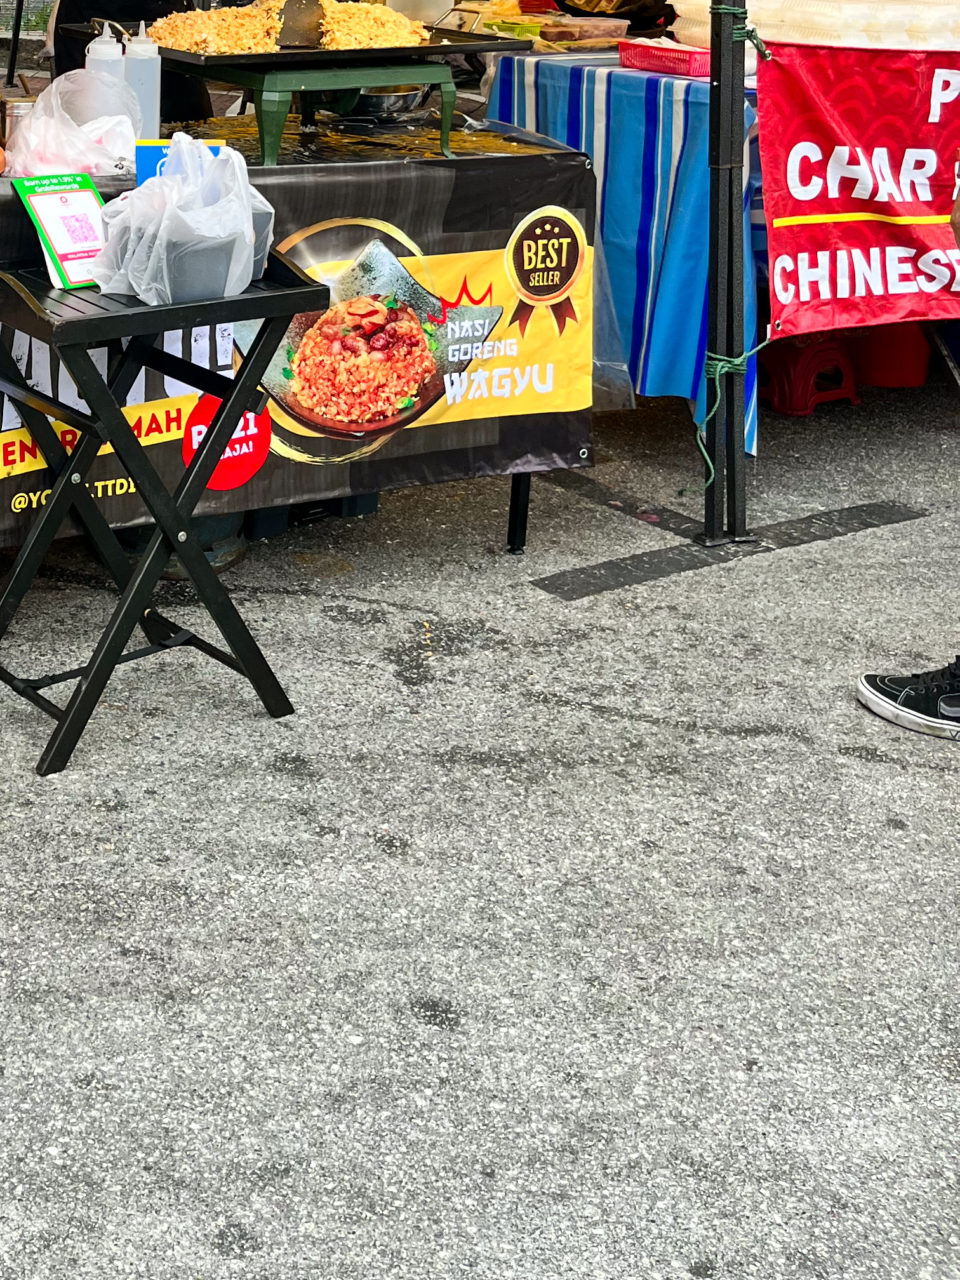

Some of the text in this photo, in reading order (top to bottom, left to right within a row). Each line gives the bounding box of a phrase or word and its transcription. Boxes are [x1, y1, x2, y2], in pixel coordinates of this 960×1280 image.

[787, 141, 937, 202] CHAR
[522, 237, 572, 270] BEST
[529, 270, 561, 287] SELLER
[447, 319, 490, 338] NASI
[447, 338, 518, 363] GORENG
[443, 363, 554, 406] WAGYU
